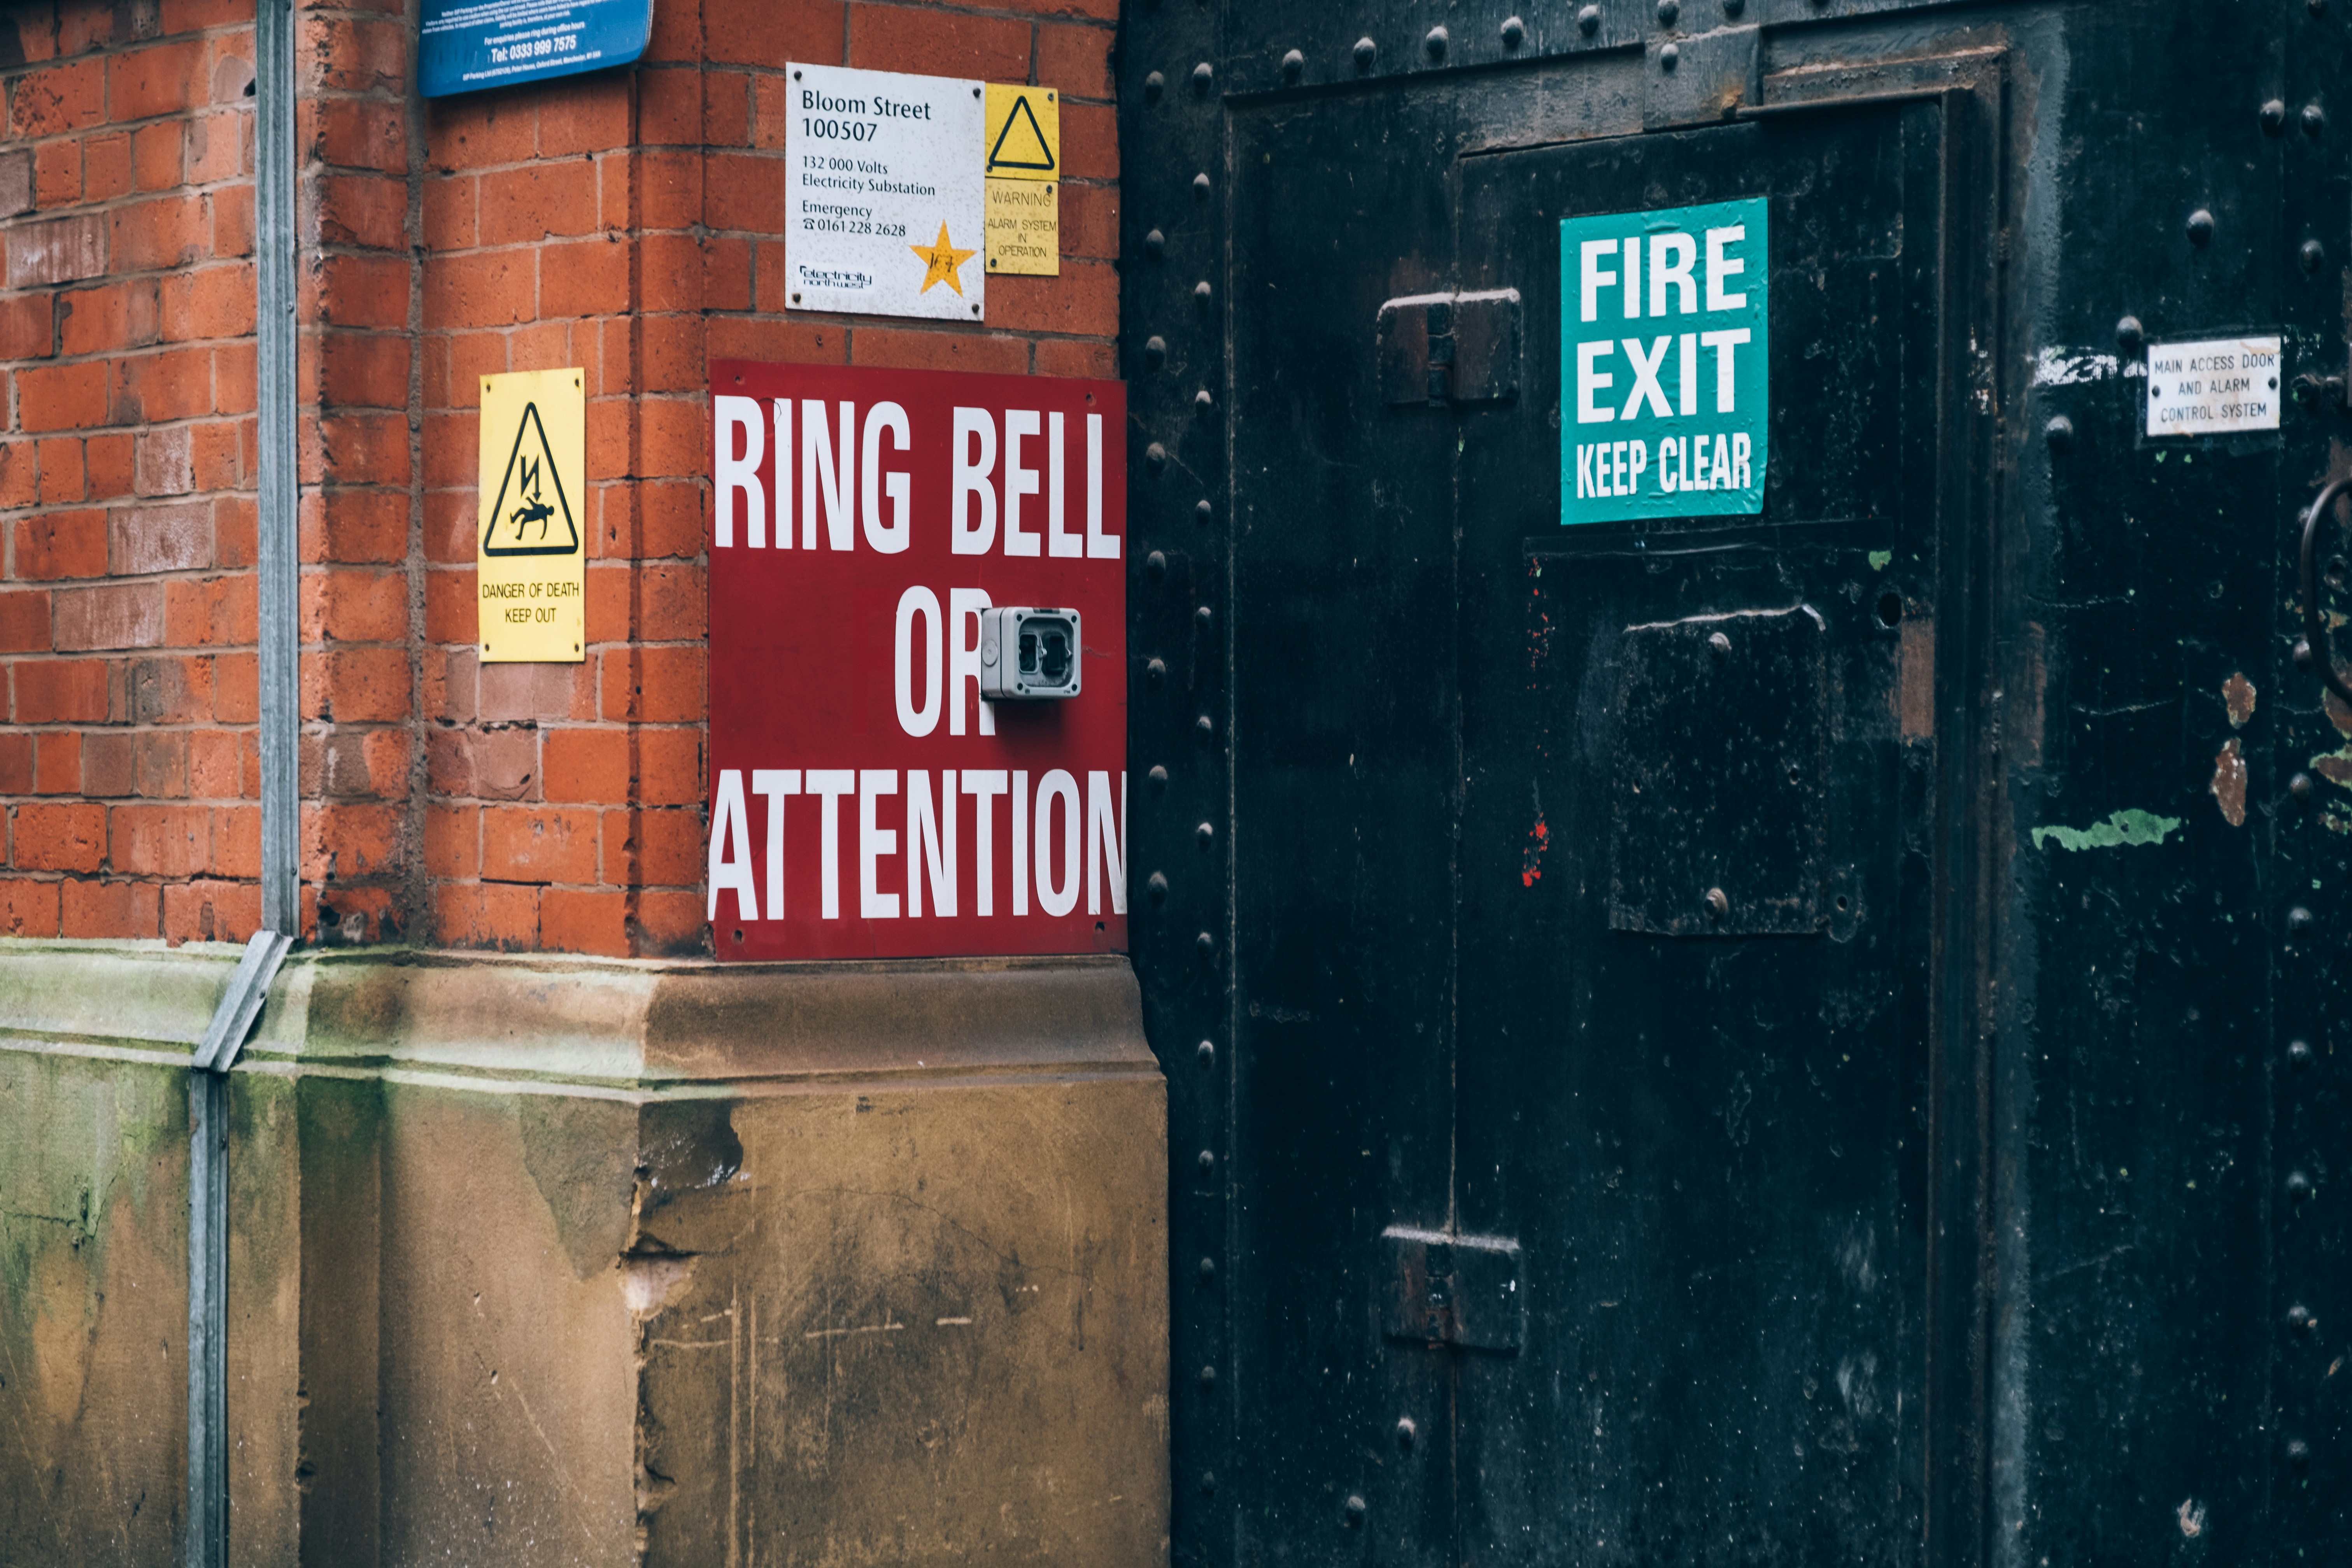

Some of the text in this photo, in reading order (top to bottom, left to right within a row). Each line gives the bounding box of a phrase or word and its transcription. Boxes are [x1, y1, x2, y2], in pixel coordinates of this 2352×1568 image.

[484, 21, 585, 46] For enquiries please ring during office hours
[491, 34, 577, 63] Tel: 0333 999 7575
[803, 90, 931, 120] Bloom Street
[803, 118, 877, 142] 100507
[803, 156, 887, 174] 132 000 Volts
[803, 173, 935, 195] Electricity Substation
[992, 191, 1051, 207] WARNING
[803, 200, 872, 221] Emergency
[818, 219, 906, 237] 0161 228 2628
[988, 219, 1056, 232] ALARM SYSTEM
[1018, 233, 1027, 243] IN
[998, 245, 1046, 258] OPERATION
[1581, 225, 1747, 322] FIRE
[2155, 353, 2274, 374] MAIN ACCESS DOOR
[1577, 328, 1751, 424] EXIT
[2178, 378, 2250, 396] AND ALARM
[2161, 403, 2266, 422] CONTROL SYSTEM
[1577, 432, 1751, 499] KEEP CLEAR
[715, 395, 1120, 559] RING BELL
[483, 582, 579, 598] DANGER OF DEATH
[505, 608, 556, 623] KEEP OUT
[895, 585, 995, 737] OR
[708, 769, 1127, 921] ATTENTION
